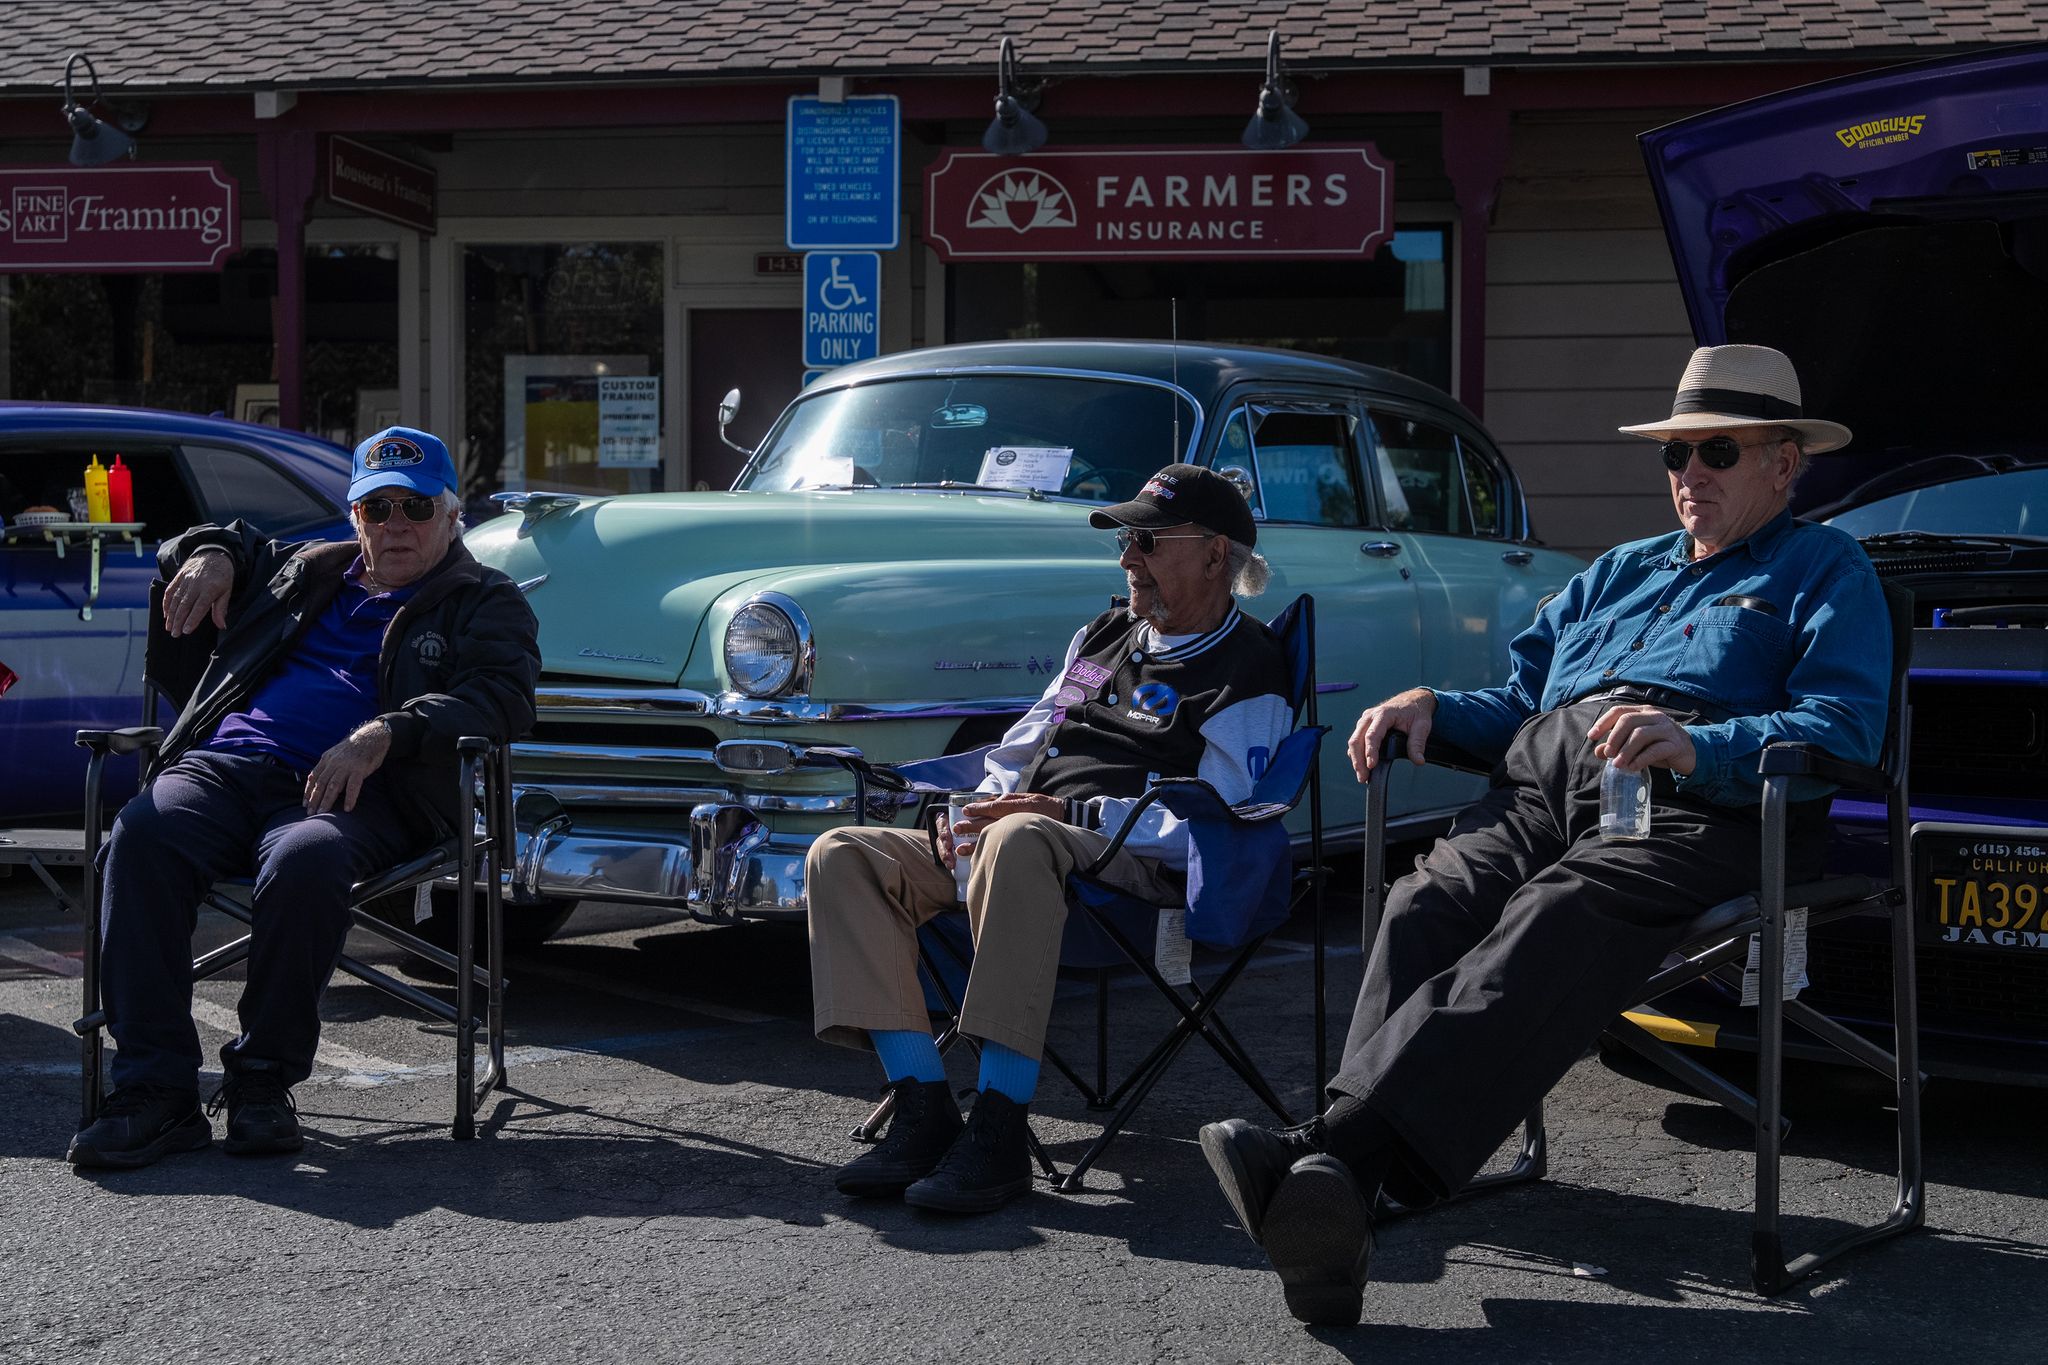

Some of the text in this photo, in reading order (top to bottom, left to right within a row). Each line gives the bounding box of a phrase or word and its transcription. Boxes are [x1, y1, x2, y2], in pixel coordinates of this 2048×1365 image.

[854, 106, 887, 115] VEHICLES
[816, 116, 830, 125] NOT
[854, 126, 889, 135] PLACARDS
[1836, 114, 1927, 148] GOODGUYS
[806, 136, 835, 145] LICENSE
[839, 136, 864, 145] PLATES
[1858, 133, 1910, 150] OFFICIAL MEMBER
[817, 146, 849, 154] DISABLED
[852, 146, 885, 154] PERSONS
[807, 156, 879, 164] WILL BE TOWED AWAY
[814, 182, 872, 191] TOWED VEHICLES
[1096, 172, 1349, 209] FARMERS
[820, 192, 829, 200] BE
[832, 192, 871, 200] RECLAIMED
[16, 195, 65, 213] FINE
[68, 195, 223, 244] Framing
[20, 214, 61, 232] ART
[808, 216, 878, 224] OR BY TELEPHONING
[1096, 220, 1265, 241] INSURANCE
[768, 257, 803, 271] 143
[809, 312, 874, 334] PARKING
[820, 338, 862, 360] ONLY
[602, 380, 656, 390] CUSTOM
[602, 392, 656, 401] FRAMING
[1071, 663, 1104, 682] Dodge
[1126, 709, 1160, 724] MOPAR
[1973, 843, 2010, 857] (415)
[1942, 926, 2048, 948] JAGM
